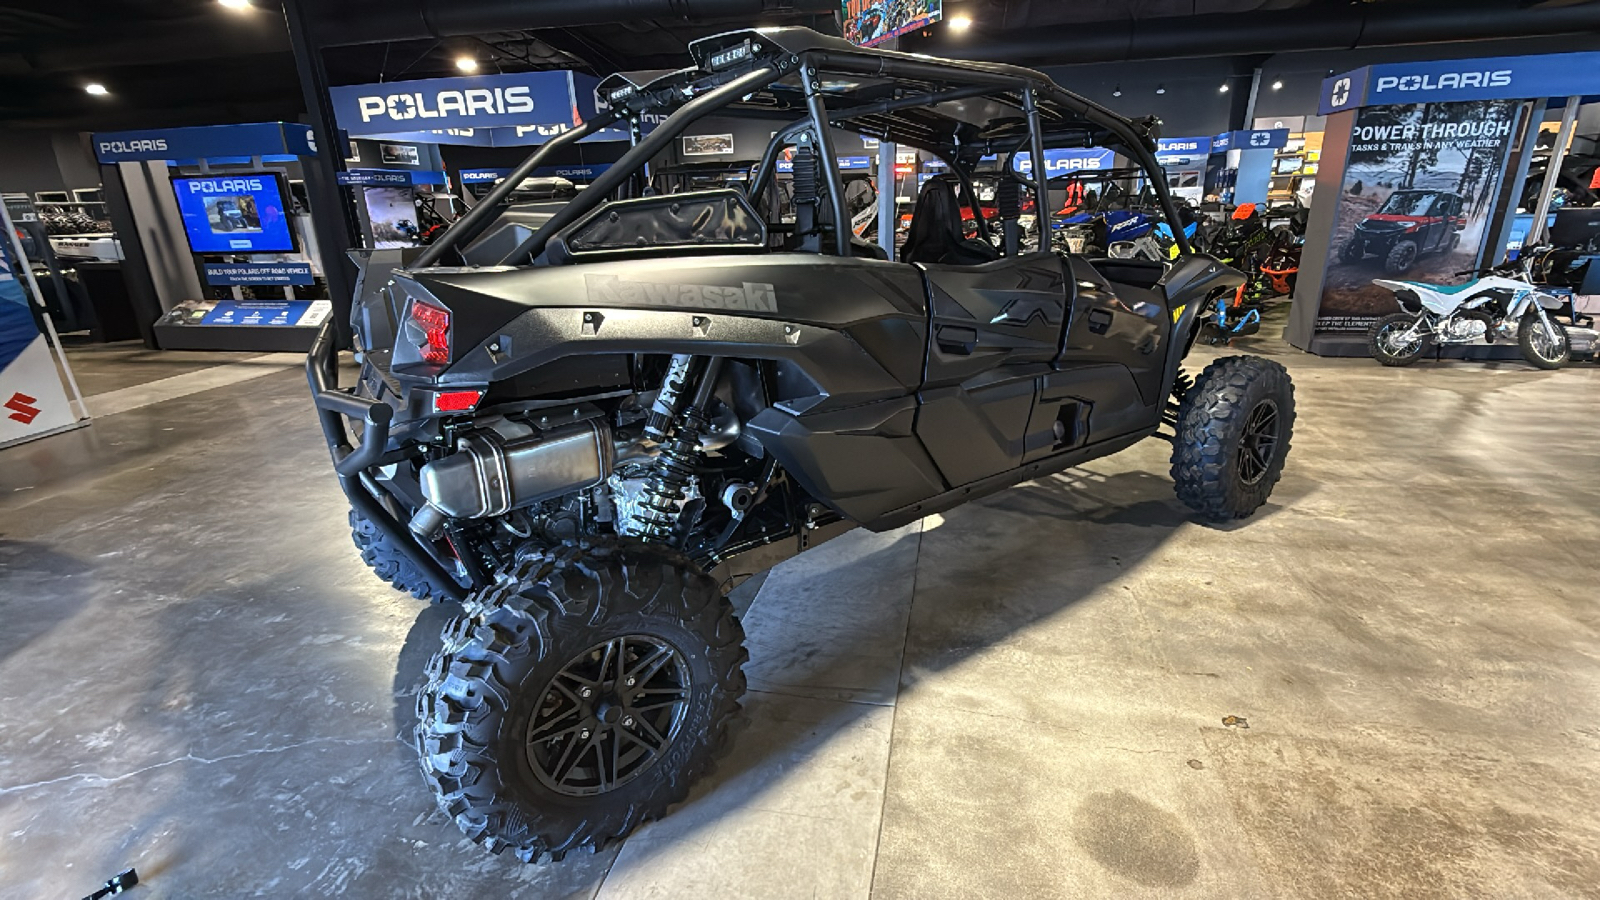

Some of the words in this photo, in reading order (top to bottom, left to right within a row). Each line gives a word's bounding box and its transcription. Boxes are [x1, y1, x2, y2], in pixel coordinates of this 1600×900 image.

[1376, 70, 1512, 92] POLARIS
[358, 86, 534, 122] POLARIS
[1420, 119, 1511, 139] THROUGH
[100, 139, 168, 154] POLARIS
[1158, 142, 1198, 151] LARIS
[1351, 143, 1379, 152] TASKS
[1381, 143, 1387, 151] &
[1390, 142, 1422, 151] TRAILS
[1423, 141, 1432, 150] IN
[1433, 140, 1454, 150] ANY
[1456, 139, 1501, 148] WEATHER
[1019, 157, 1100, 171] PLARIS
[374, 174, 405, 183] OLARIS
[463, 172, 498, 180] POLARIS
[555, 168, 592, 176] POLARIS
[188, 179, 263, 194] POLARIS
[237, 267, 260, 275] POLARIS
[287, 267, 309, 275] VEHICLE
[584, 273, 778, 313] Kawasaki
